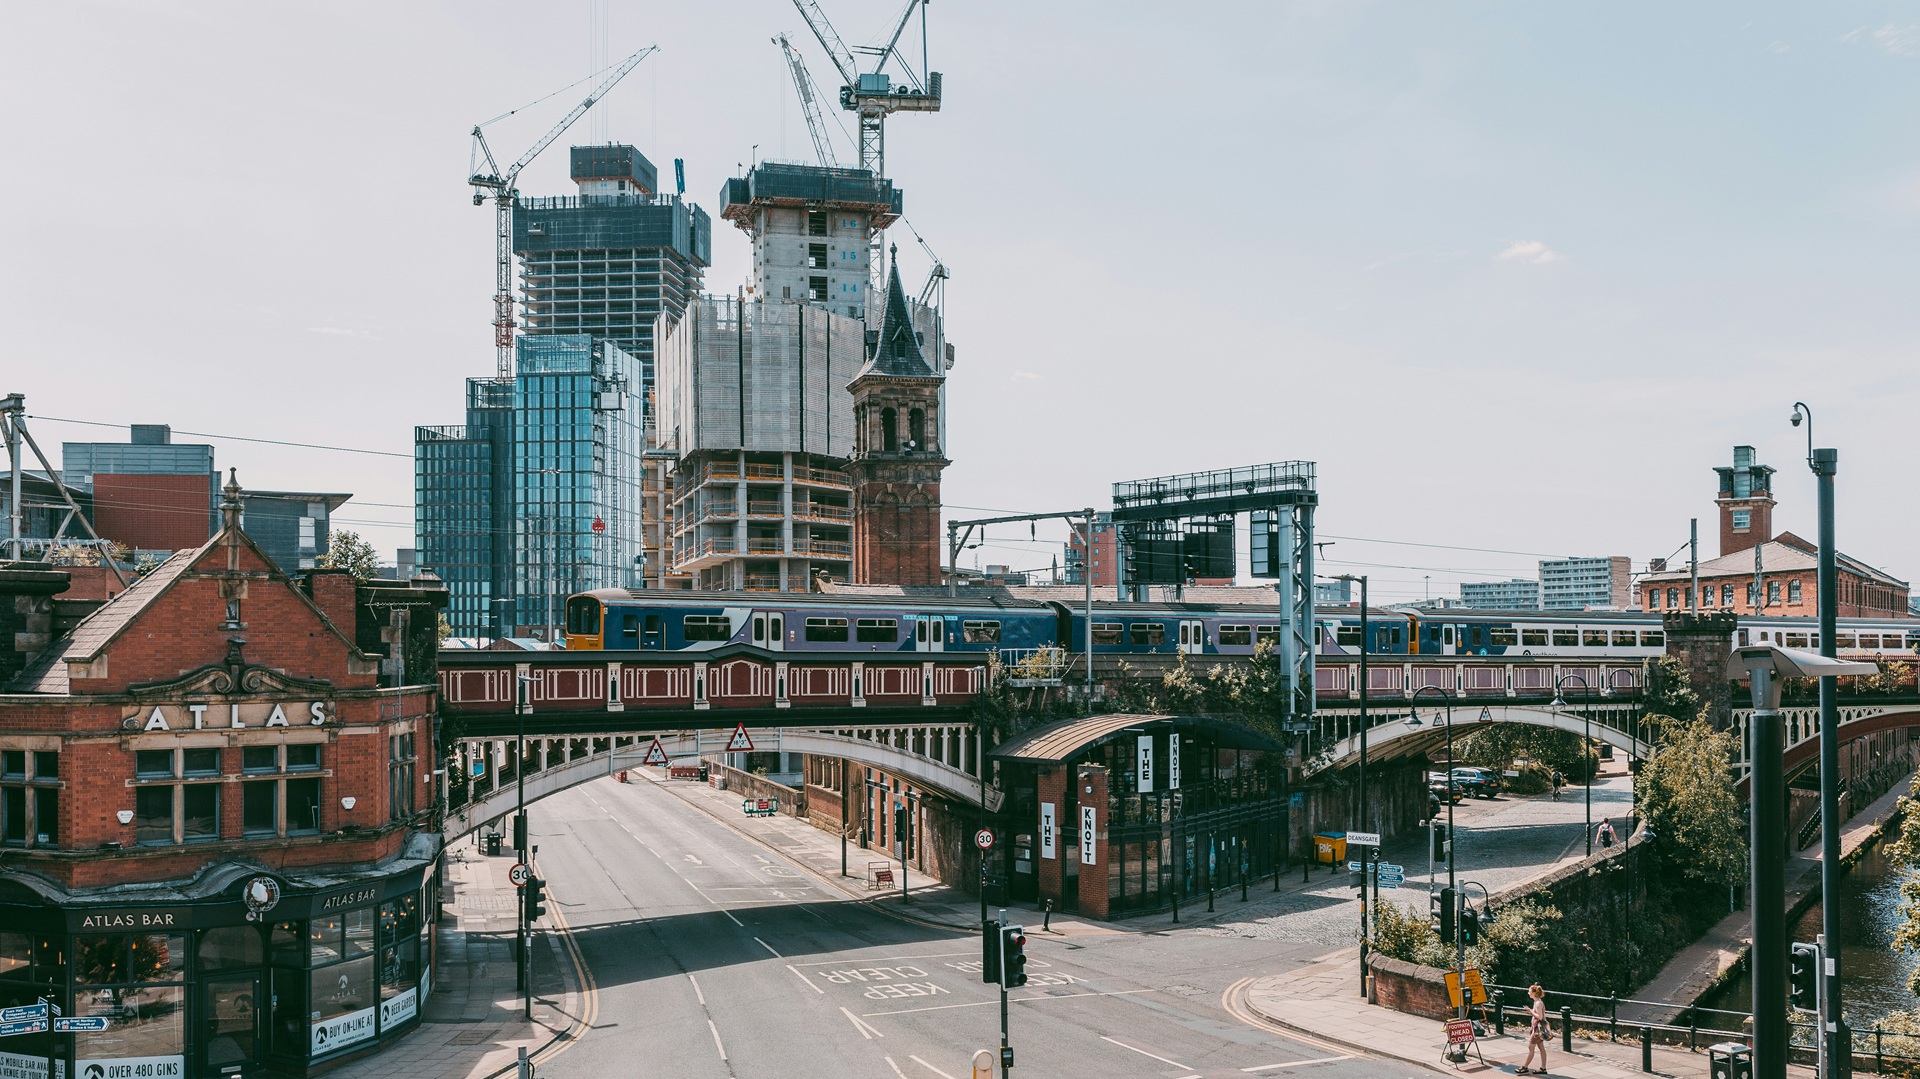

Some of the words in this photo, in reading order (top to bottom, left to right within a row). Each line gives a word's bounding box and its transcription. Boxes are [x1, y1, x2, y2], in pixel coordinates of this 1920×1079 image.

[841, 218, 857, 228] 16
[841, 251, 857, 260] 15
[841, 283, 857, 293] 14
[144, 701, 326, 731] ATLAS
[1142, 748, 1150, 780] THE
[980, 834, 992, 844] 30
[1084, 808, 1092, 863] KNOTT
[1347, 834, 1379, 843] DEANSGATE
[323, 893, 354, 910] ATLAS
[357, 889, 376, 902] BAR
[82, 914, 135, 928] ATLAS
[142, 913, 175, 926] BAR
[818, 966, 929, 984] CLEAR
[331, 988, 356, 1001] ATLAS
[864, 981, 951, 1000] KEEP
[391, 1002, 401, 1016] BEER
[401, 995, 416, 1011] GARDEN
[329, 1024, 341, 1039] BUY
[342, 1017, 365, 1034] ON-LINE
[366, 1014, 373, 1027] AT
[1448, 1022, 1471, 1030] FOOTPATH
[1451, 1028, 1470, 1036] AHEAD
[1450, 1035, 1473, 1044] CLOSED
[5, 1057, 24, 1068] MOBILE
[25, 1059, 36, 1070] BAR
[109, 1065, 132, 1078] OVER
[135, 1063, 153, 1077] 480
[156, 1062, 178, 1076] GINS
[3, 1067, 20, 1079] VENUE
[20, 1069, 27, 1079] OF
